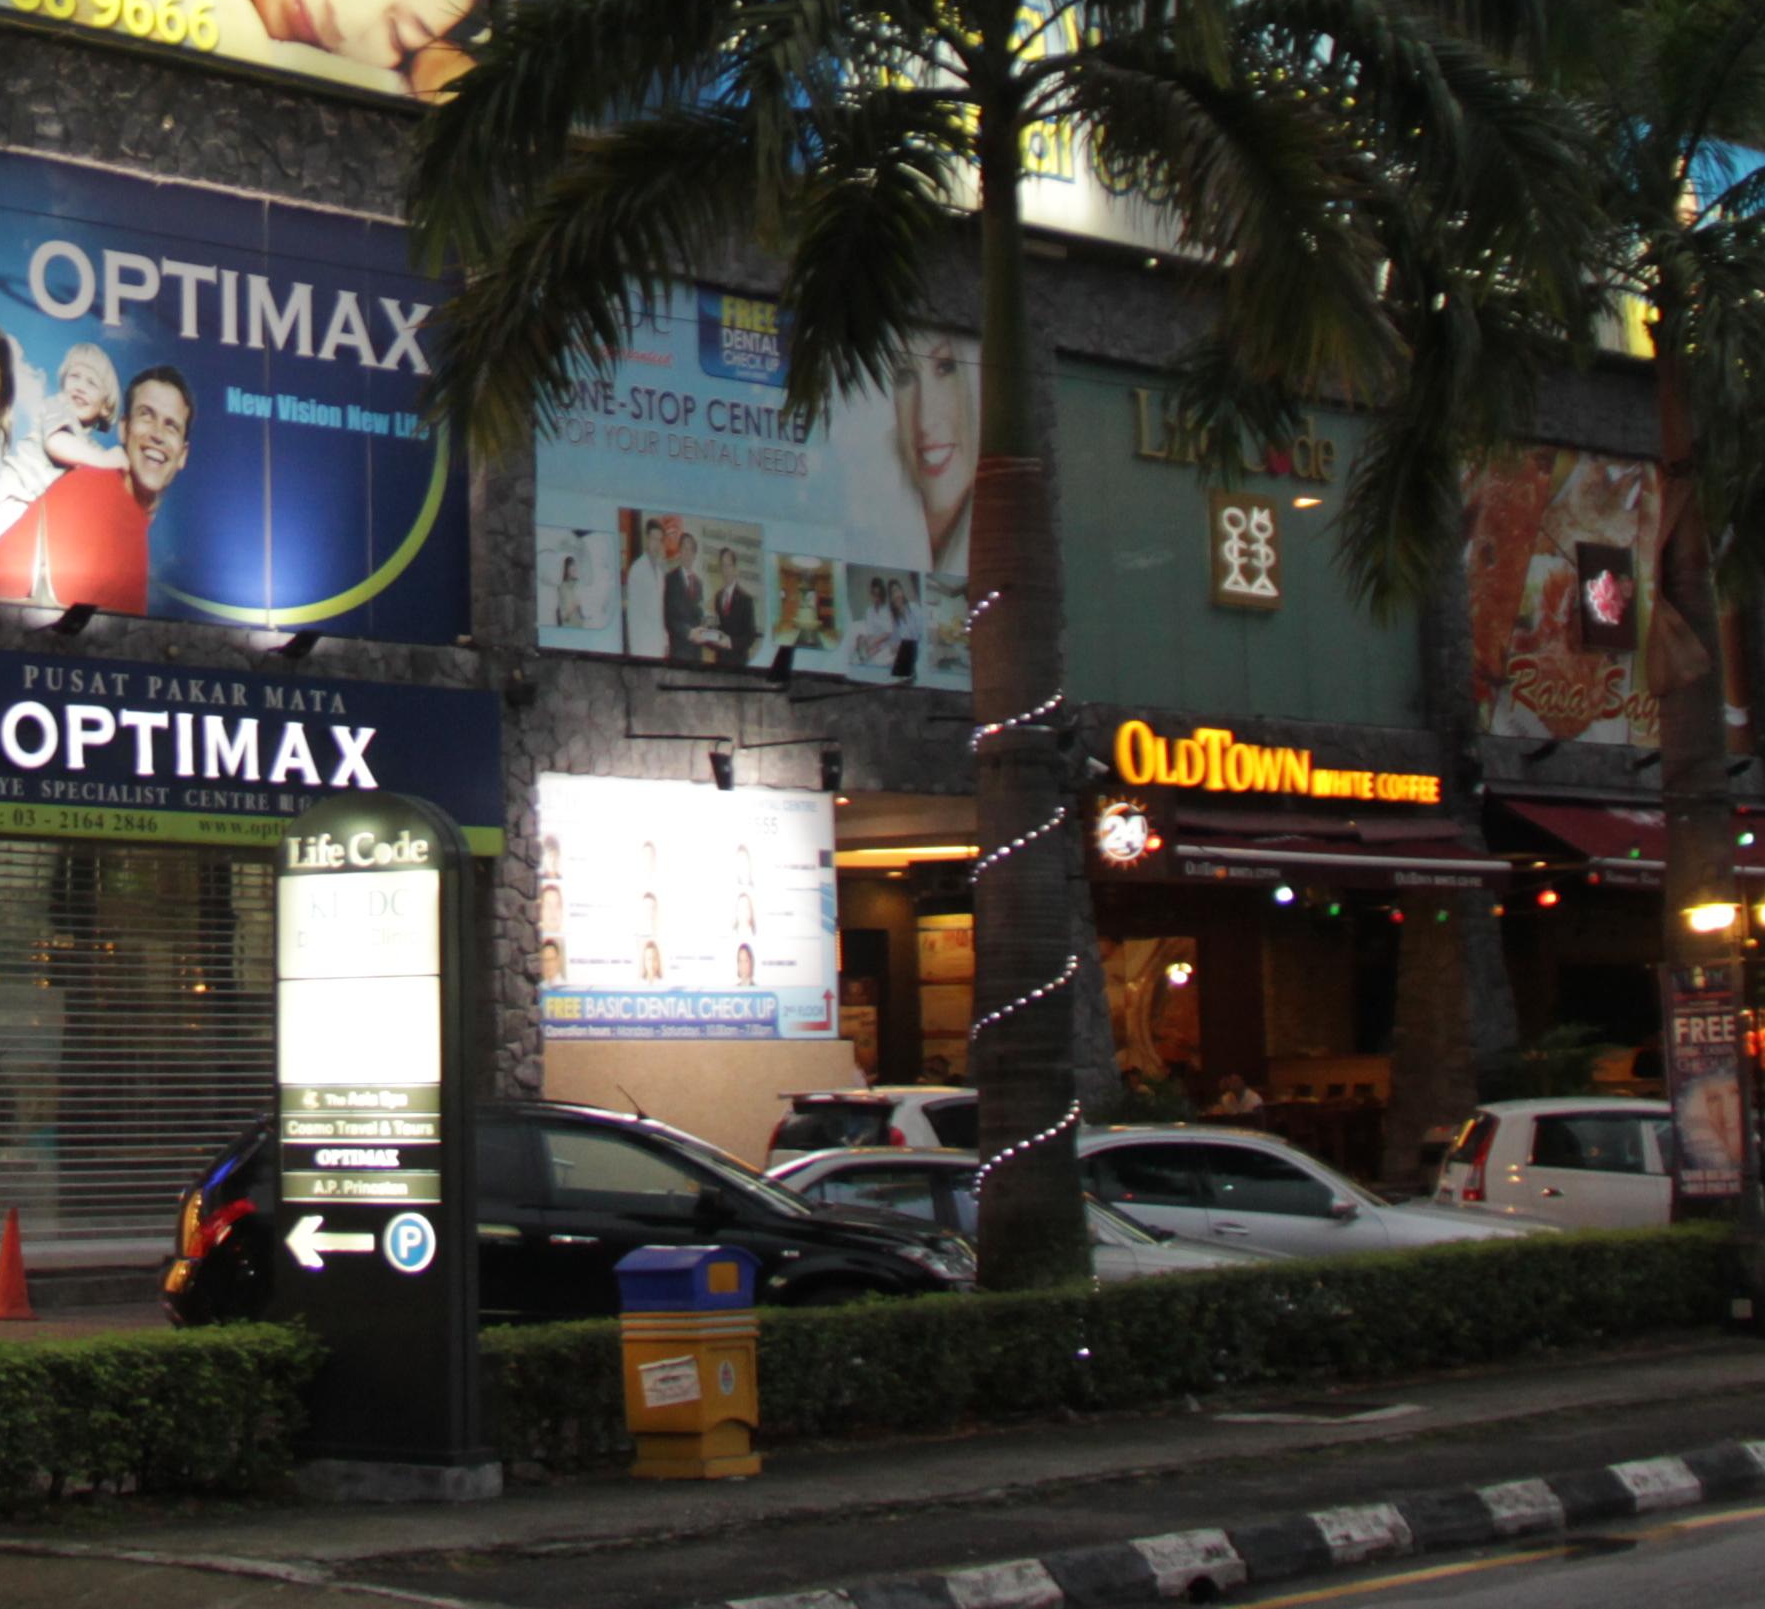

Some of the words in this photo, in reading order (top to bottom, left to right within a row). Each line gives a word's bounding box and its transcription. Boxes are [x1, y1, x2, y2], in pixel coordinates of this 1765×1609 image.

[28, 241, 433, 375] OPTIMAX
[722, 295, 780, 335] FREE
[722, 327, 780, 357] DENTAL
[227, 386, 272, 418] New
[277, 394, 342, 428] Vision
[347, 405, 389, 435] New
[707, 399, 806, 444] CENTRE
[604, 424, 659, 457] YOUR
[668, 433, 742, 468] DENTAL
[749, 446, 809, 477] NEEDS
[23, 665, 129, 696] PUSAT
[148, 675, 247, 706] PAKAR
[265, 686, 346, 714] MATA
[0, 701, 379, 789] OPTIMAX
[41, 780, 169, 805] SPECIALIST
[185, 789, 269, 811] CENTRE
[1311, 768, 1374, 799] WHITE
[1376, 772, 1440, 804] COFFEE
[13, 807, 36, 827] 03
[59, 811, 105, 830] 2164
[112, 814, 158, 833] 2846
[198, 816, 285, 839] www.opti
[286, 835, 345, 869] Life
[349, 831, 428, 867] Code
[544, 996, 581, 1019] FREE
[585, 996, 633, 1019] BASIC
[636, 996, 696, 1019] DENTAL
[699, 996, 753, 1019] CHECK
[756, 996, 777, 1019] UP
[1674, 1016, 1736, 1043] FREE
[287, 1120, 334, 1136] Cosmo
[335, 1120, 378, 1136] Travel
[392, 1120, 435, 1136] Tours
[315, 1149, 400, 1166] OPTIMAX
[400, 1227, 422, 1256] P
